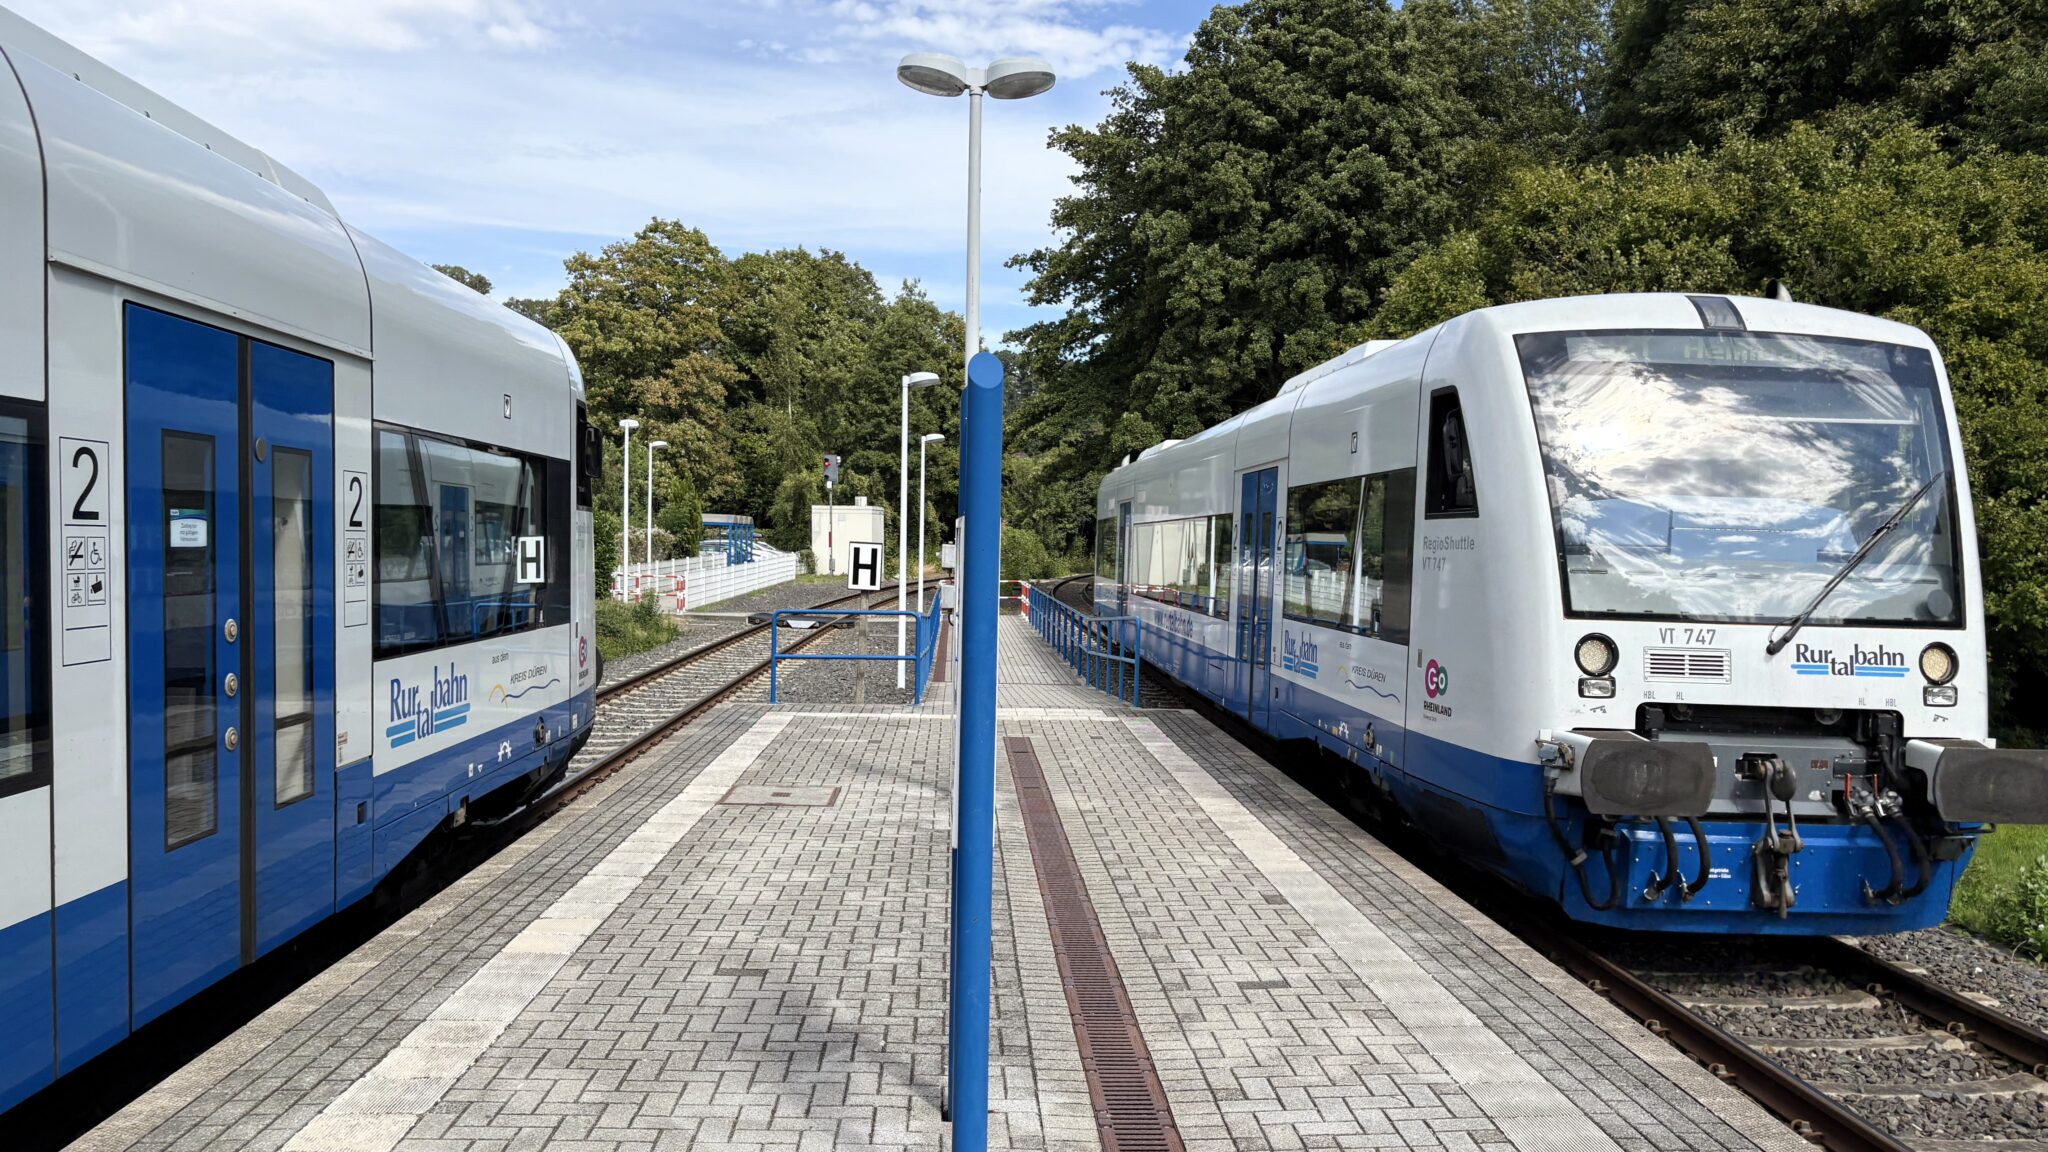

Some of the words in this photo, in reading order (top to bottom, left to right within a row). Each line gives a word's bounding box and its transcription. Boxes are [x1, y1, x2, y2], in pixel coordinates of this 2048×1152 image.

[72, 446, 99, 520] 2
[349, 476, 362, 527] 2
[1276, 520, 1283, 551] 2
[1423, 535, 1475, 554] RegioShuttle
[852, 546, 878, 587] H
[1422, 556, 1432, 571] VT
[1432, 556, 1446, 571] 747
[1659, 627, 1675, 644] VT
[1684, 628, 1716, 646] 747
[510, 670, 527, 684] KREIS
[528, 664, 547, 679] DÜREN
[1643, 690, 1656, 700] HBL
[1676, 691, 1684, 701] HL
[1858, 697, 1866, 706] HL
[1885, 698, 1898, 707] HBL
[1423, 700, 1452, 717] RHEINLAND
